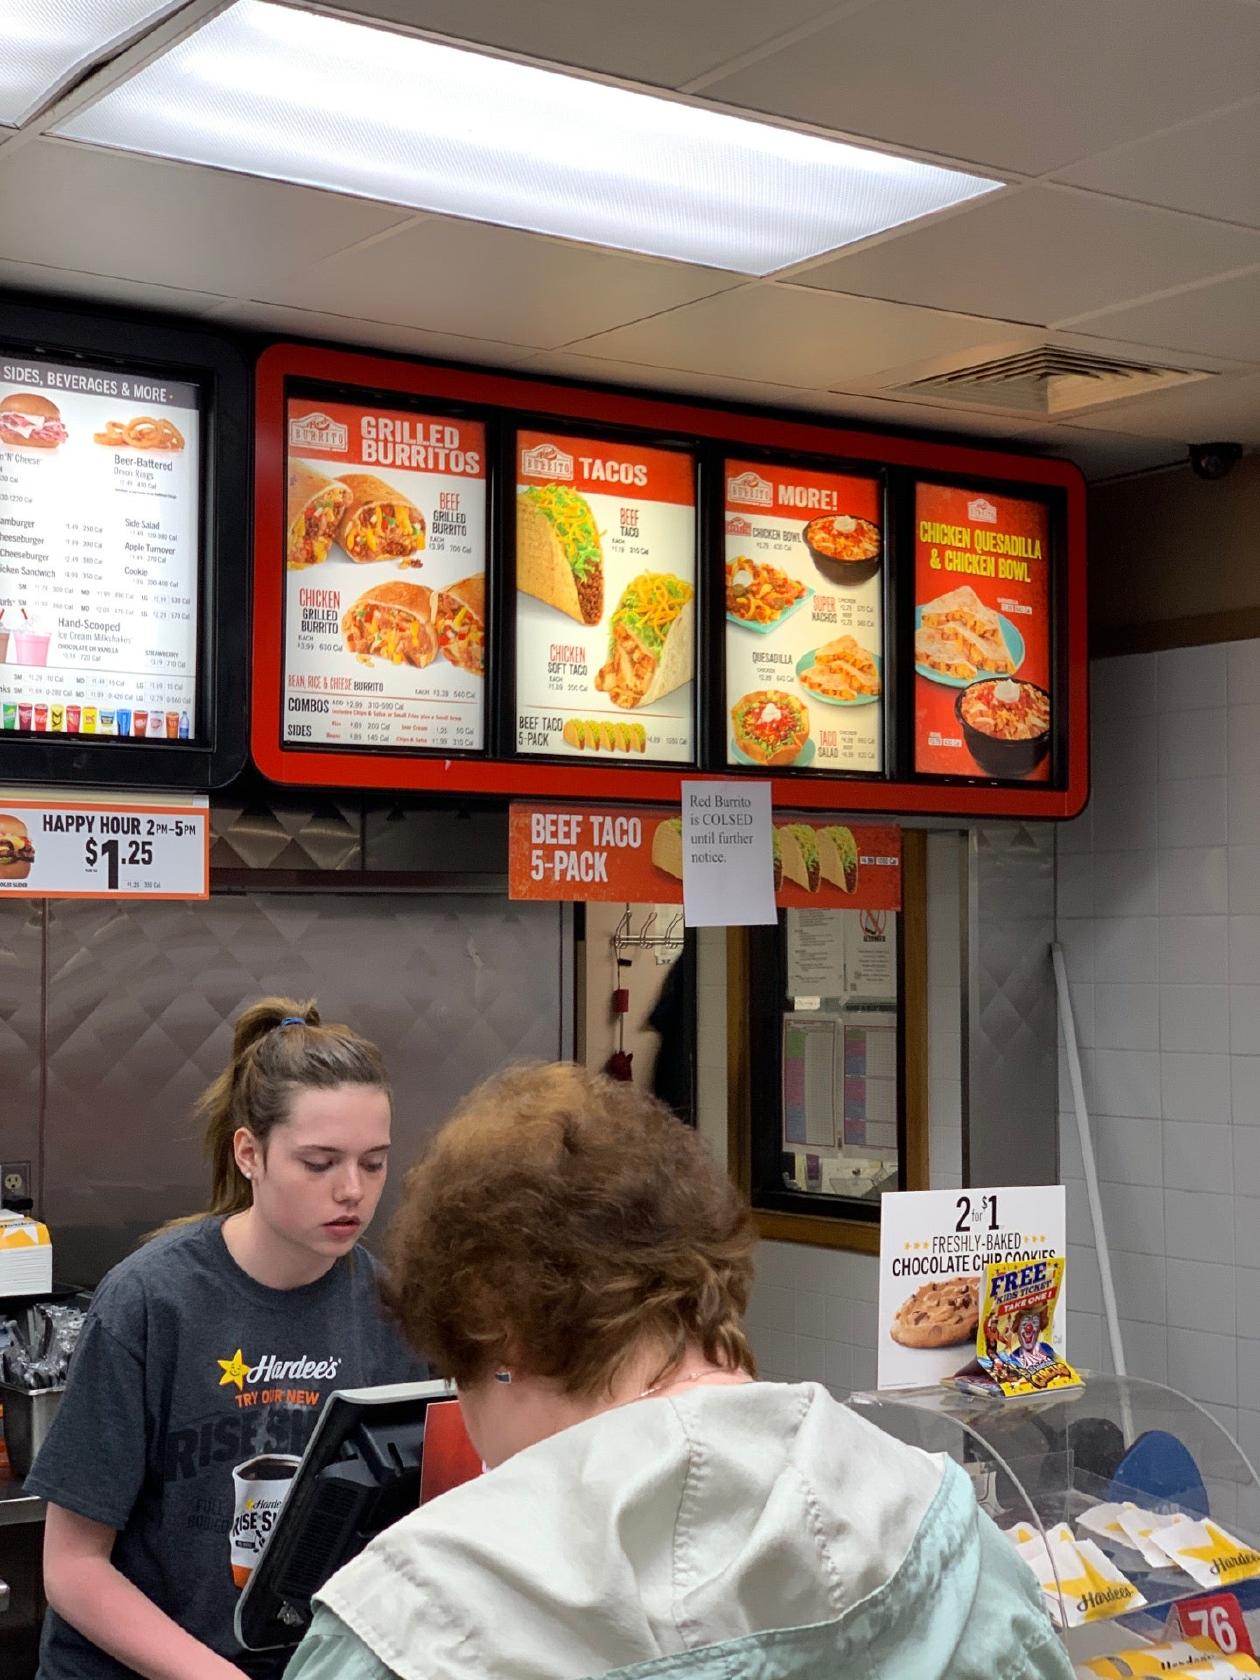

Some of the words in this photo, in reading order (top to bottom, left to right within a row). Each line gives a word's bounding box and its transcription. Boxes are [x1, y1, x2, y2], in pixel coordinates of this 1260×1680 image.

[3, 365, 43, 386] SIDES,
[47, 371, 117, 396] BEVERAGES
[121, 382, 130, 396] &
[133, 385, 167, 403] MORE
[295, 428, 344, 445] BURRITO
[361, 415, 460, 449] GRILLED
[114, 454, 173, 472] Beer-Battered
[362, 438, 481, 474] BURRITOS
[578, 457, 648, 487] TACOS
[440, 492, 460, 511] BEEF
[778, 484, 838, 511] MORE!
[0, 516, 35, 529] amburger
[433, 510, 466, 524] GRILLED
[620, 507, 639, 526] BEEF
[432, 522, 467, 536] BURRITO
[620, 526, 639, 538] TACO
[0, 532, 44, 545] heeseburger
[920, 520, 971, 549] CHICKEN
[974, 529, 1042, 560] QUESADILLA
[124, 566, 148, 577] Cookie
[930, 548, 941, 569] &
[944, 550, 995, 577] CHICKEN
[998, 558, 1031, 582] BOWL
[299, 587, 340, 609] CHICKEN
[302, 608, 338, 621] GRILLED
[58, 617, 121, 632] Hand-Scooped
[301, 620, 338, 634] BURRITO
[550, 644, 585, 664] CHICKEN
[548, 662, 566, 674] SOFT
[569, 663, 587, 676] TACO
[354, 681, 384, 692] BURRITO
[288, 697, 329, 713] COMBOS
[287, 724, 312, 737] SIDES
[519, 716, 539, 731] BEEF
[542, 717, 563, 732] TACO
[518, 732, 549, 747] 5-PACK
[690, 795, 711, 808] Red
[715, 795, 751, 808] Burrito
[43, 814, 95, 834] HAPPY
[100, 816, 141, 836] HOUR
[690, 813, 699, 825] is
[702, 813, 753, 826] COLSED
[531, 813, 582, 846] BEEF
[589, 815, 642, 849] TACO
[691, 832, 715, 844] until
[718, 831, 754, 844] further
[691, 850, 727, 863] notice.
[531, 850, 608, 883] 5-PACK
[955, 1196, 971, 1232] 2
[932, 1232, 1021, 1254] FRESHLY-BAKED
[892, 1255, 970, 1276] CHOCOLATE
[990, 1262, 1047, 1298] FREE
[1020, 1280, 1052, 1297] TICKET
[1004, 1300, 1027, 1312] TAKE
[246, 1355, 338, 1384] Hardee's
[235, 1392, 258, 1408] TRY
[261, 1389, 282, 1404] OUR
[287, 1389, 319, 1405] NEW
[1188, 1606, 1237, 1654] 76
